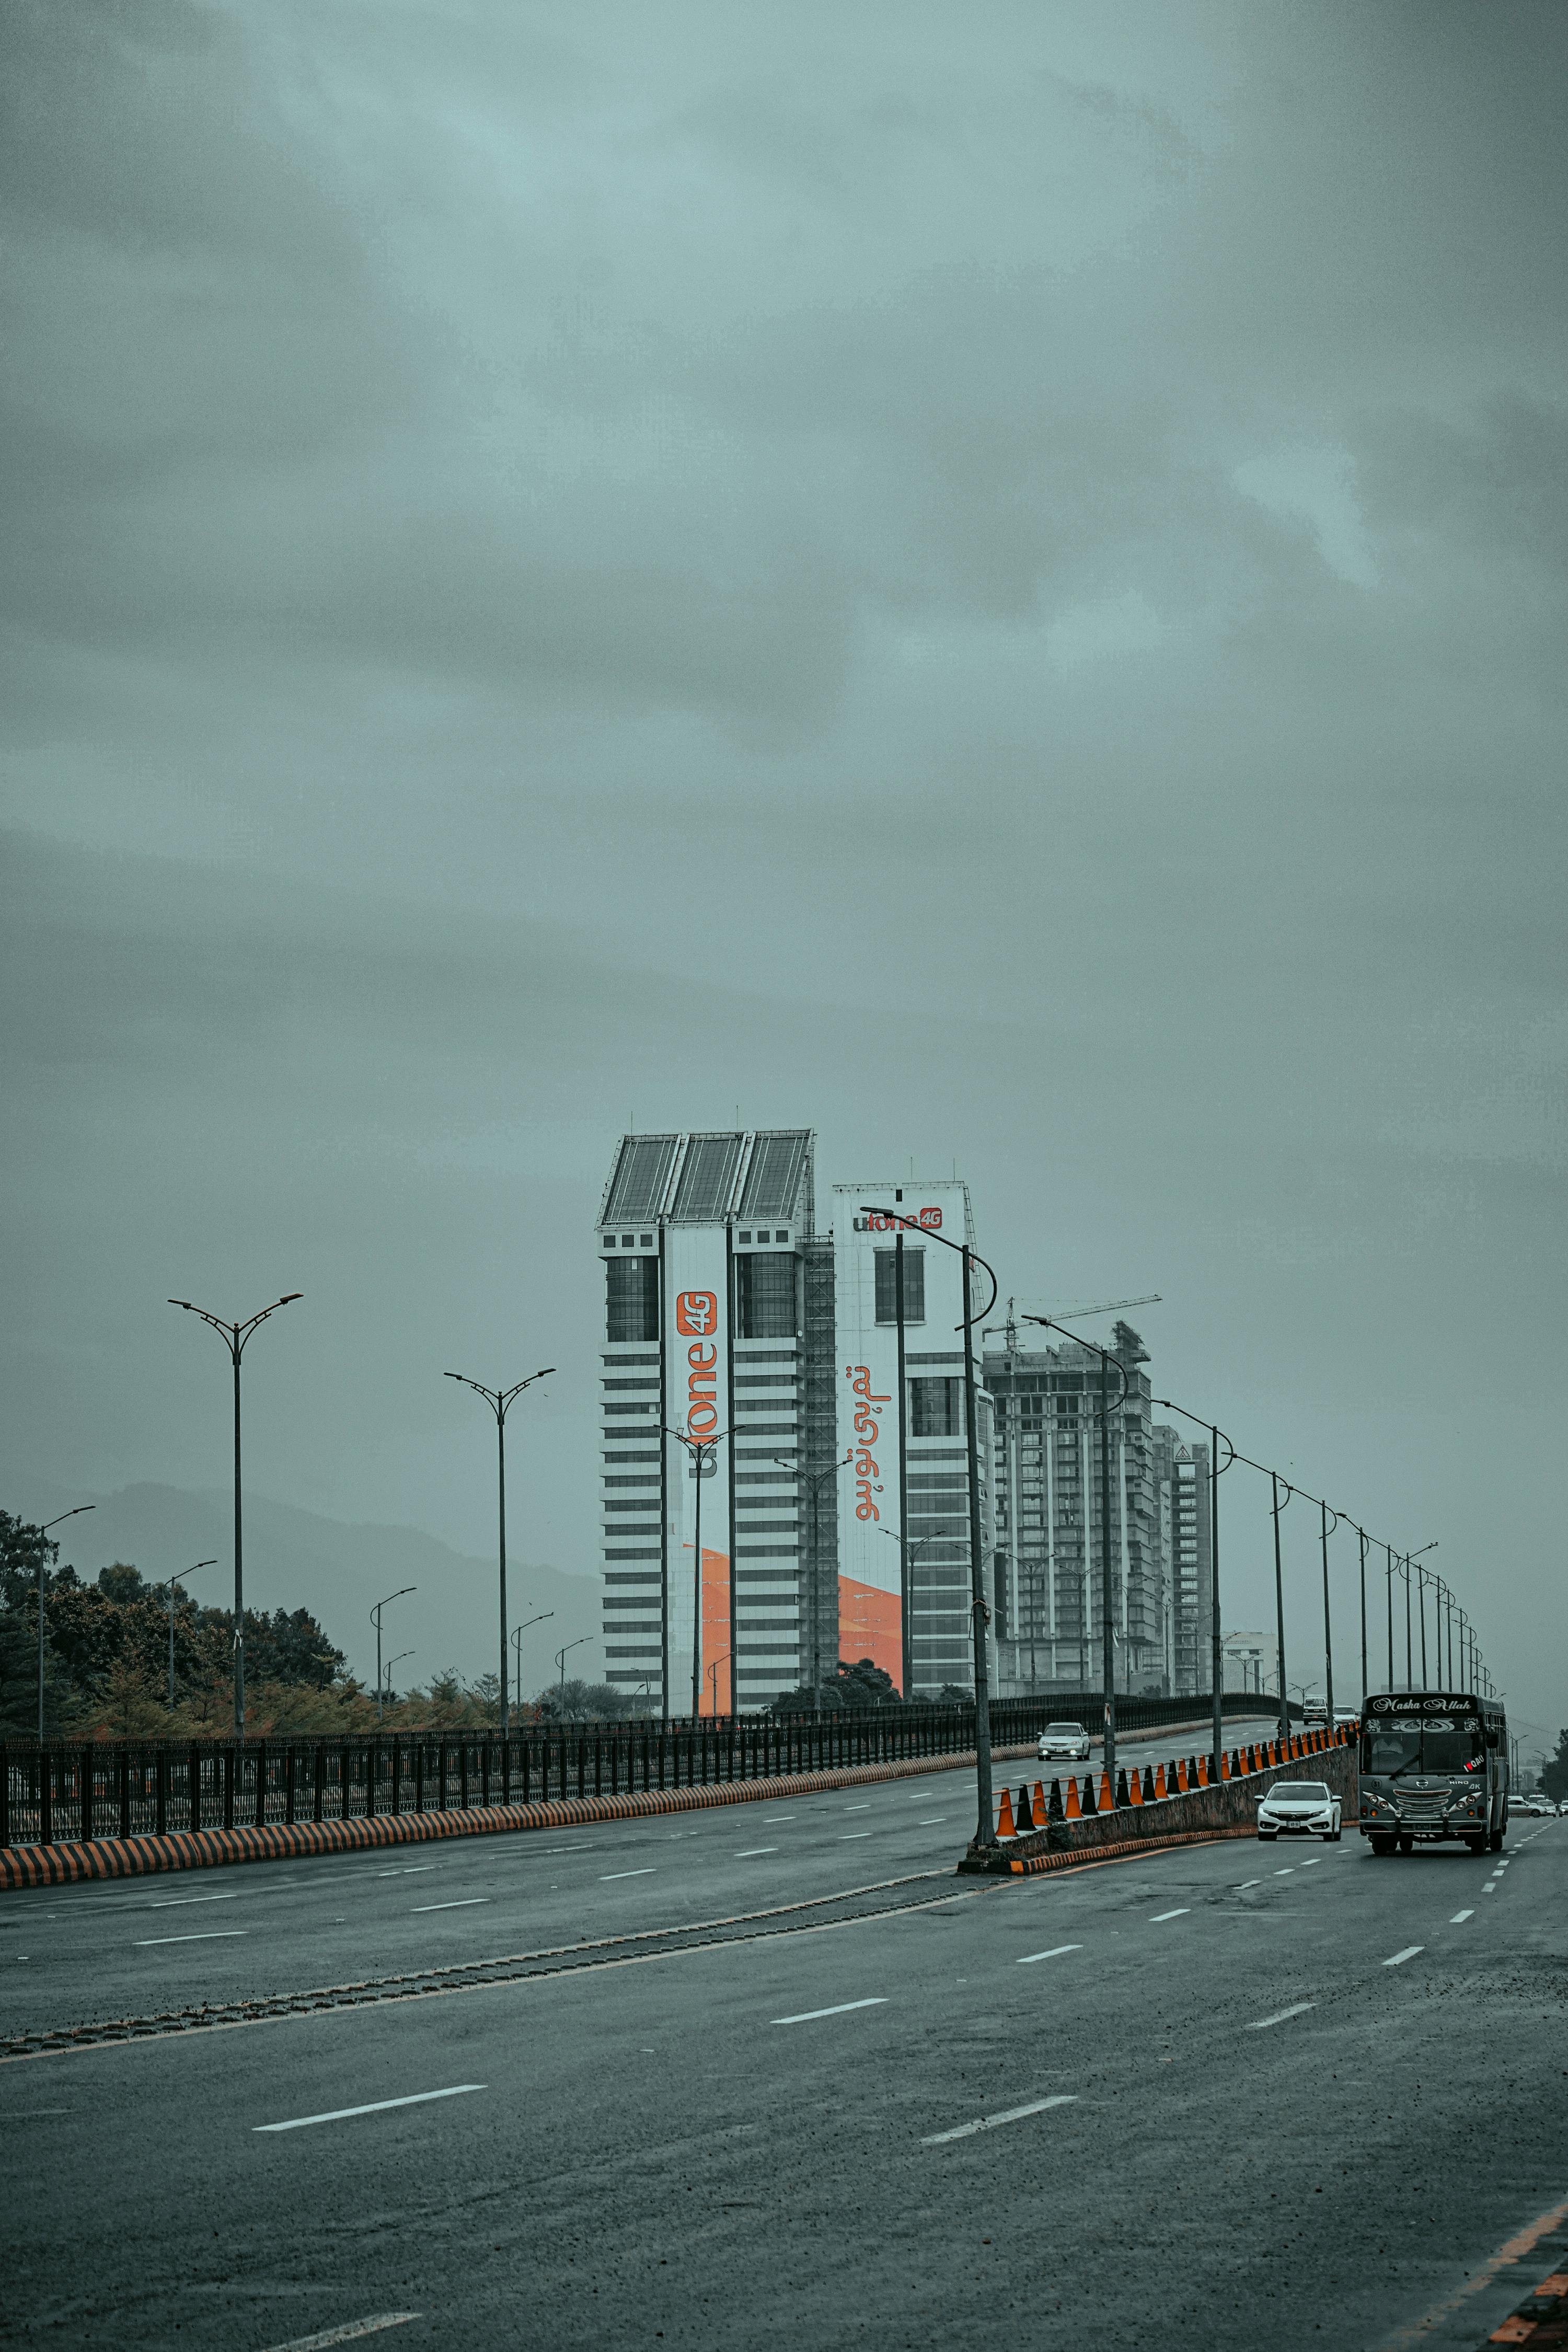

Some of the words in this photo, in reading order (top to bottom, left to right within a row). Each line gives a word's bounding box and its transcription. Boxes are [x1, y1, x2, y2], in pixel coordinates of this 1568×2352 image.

[921, 1210, 941, 1226] 4G
[684, 1294, 711, 1334] 4G
[846, 1366, 891, 1401] تم
[847, 1449, 879, 1477] تو
[1373, 1698, 1421, 1712] Masha
[1423, 1699, 1471, 1711] Allah
[1471, 1755, 1484, 1768] QAU
